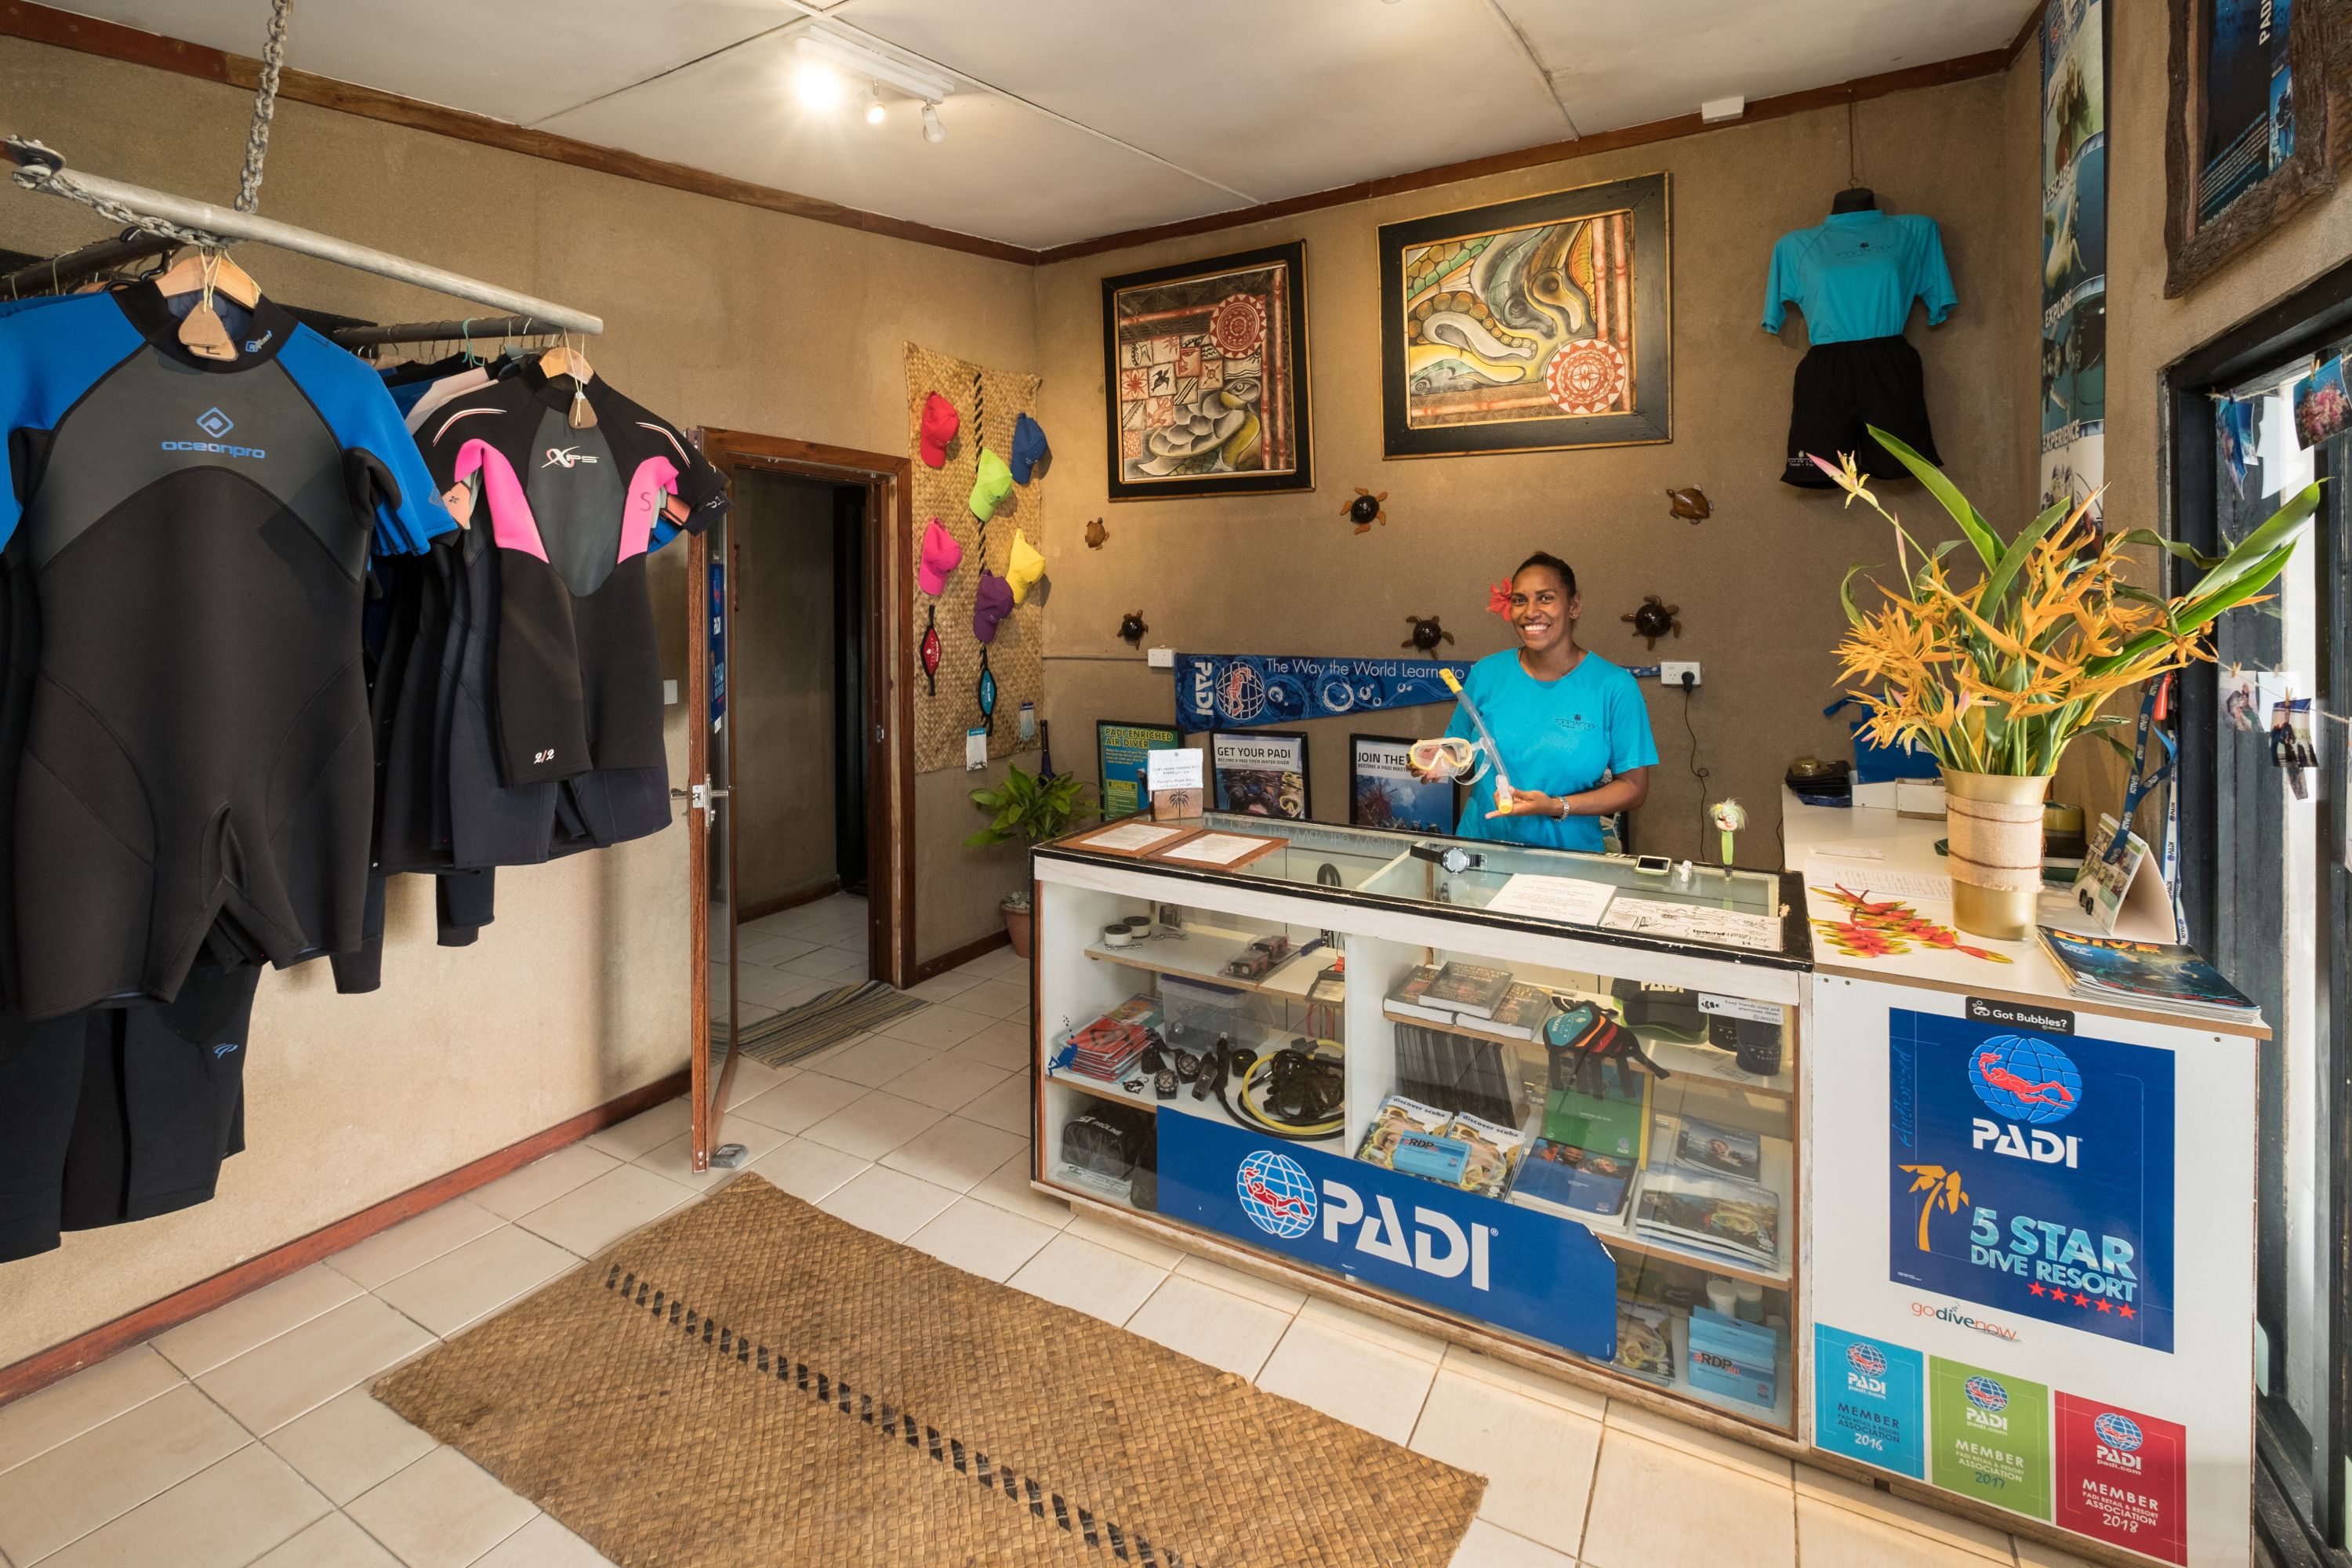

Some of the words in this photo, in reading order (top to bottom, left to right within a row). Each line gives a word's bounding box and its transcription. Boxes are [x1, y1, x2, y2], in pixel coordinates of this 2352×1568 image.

[2047, 159, 2071, 203] ESCAPE
[2045, 289, 2072, 328] EXPLORE
[2042, 419, 2080, 452] EXPERIENCE
[162, 441, 266, 459] oceanpro
[639, 492, 652, 512] S
[1266, 658, 1288, 673] The
[1292, 659, 1325, 678] Way
[1330, 660, 1349, 677] the
[1353, 660, 1396, 677] World
[1451, 666, 1465, 680] to
[1194, 662, 1213, 717] PADI
[1105, 728, 1126, 737] PADI
[1128, 729, 1174, 741] ENRICHED
[1105, 737, 1120, 746] AIR
[1123, 739, 1150, 749] DIVER
[533, 749, 554, 764] 2/2
[1217, 746, 1236, 757] GET
[1237, 747, 1265, 757] YOUR
[1267, 749, 1291, 759] PADI
[1358, 752, 1380, 764] JOIN
[1383, 754, 1406, 766] THE
[2054, 930, 2160, 953] DIVE
[1992, 1009, 2014, 1020] Got
[2016, 1012, 2067, 1028] Bubbles?
[1393, 1097, 1423, 1112] discover
[1424, 1109, 1446, 1118] scuba
[1892, 1044, 1914, 1148] Authorized
[1092, 1121, 1123, 1137] PROLINE
[1462, 1114, 1495, 1131] discover
[1496, 1127, 1519, 1138] scuba
[1973, 1117, 2078, 1169] PADI
[1323, 1179, 1490, 1292] PADI
[1969, 1206, 1999, 1247] 5
[2009, 1215, 2138, 1280] STAR
[1971, 1244, 2028, 1277] DIVE
[2036, 1259, 2137, 1302] RESORT
[1911, 1303, 2017, 1340] godivenow
[1848, 1372, 1886, 1394] PADI
[1848, 1385, 1886, 1399] padi.com
[1838, 1402, 1900, 1429] MEMBER
[1838, 1414, 1851, 1422] PADI
[1966, 1406, 2008, 1431] PADI
[1838, 1419, 1900, 1443] ASSOCIATION
[1966, 1421, 2008, 1436] padi.com
[1855, 1432, 1883, 1451] 2016
[1955, 1439, 2024, 1468] MEMBER
[1955, 1450, 1971, 1460] PADI
[1973, 1455, 1992, 1466] RETAIL
[2000, 1464, 2024, 1475] RESORT
[2096, 1444, 2142, 1470] PADI
[2096, 1459, 2142, 1475] padi.com
[1958, 1458, 2023, 1483] ASSOCIATION
[1975, 1471, 2005, 1490] 2017
[2082, 1479, 2158, 1512] MEMBER
[2082, 1491, 2100, 1501] PADI
[2101, 1497, 2123, 1508] RETAIL
[2132, 1506, 2158, 1519] RESORT
[2085, 1499, 2157, 1526] ASSOCIATION
[2103, 1512, 2139, 1534] 2018
